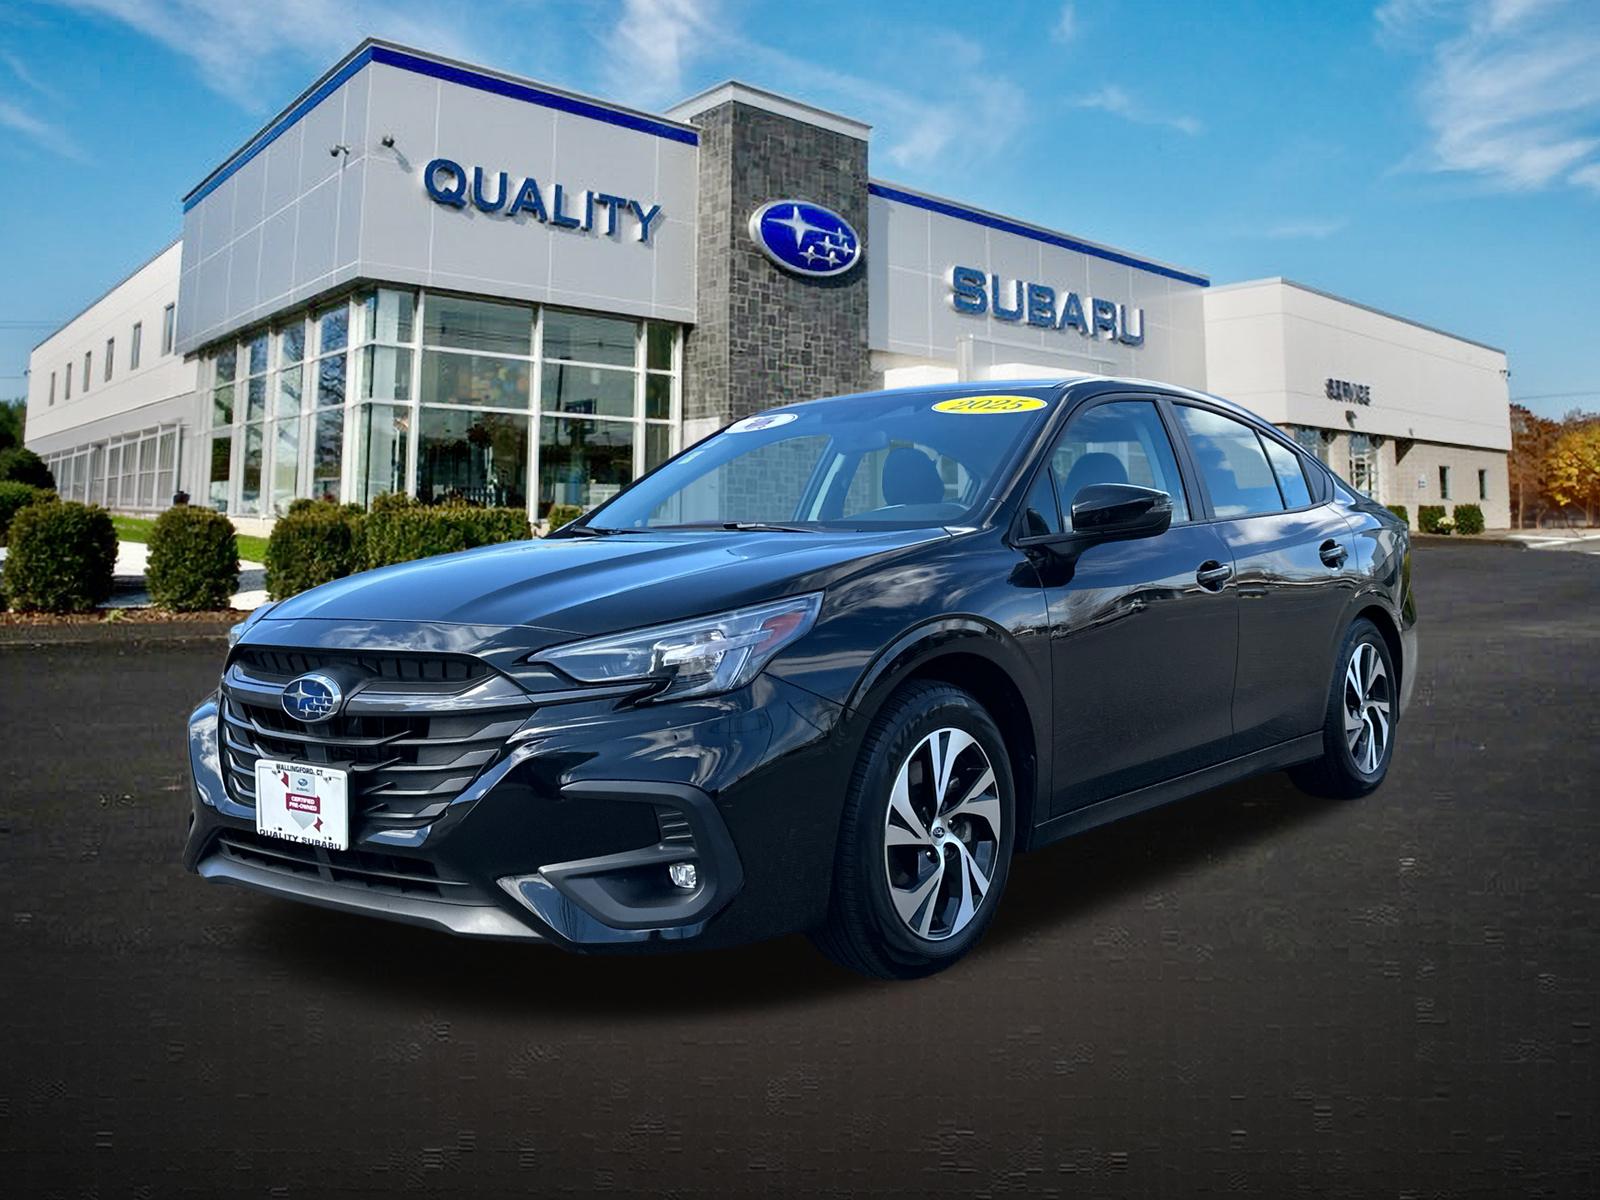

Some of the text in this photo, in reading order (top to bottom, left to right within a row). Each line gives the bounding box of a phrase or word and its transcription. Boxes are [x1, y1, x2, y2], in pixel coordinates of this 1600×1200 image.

[424, 158, 662, 242] QUALITY
[951, 265, 1144, 346] SUBARU
[947, 399, 1030, 410] 2025
[1325, 378, 1370, 405] SERVICE
[260, 829, 341, 850] QUALITY SUBARU
